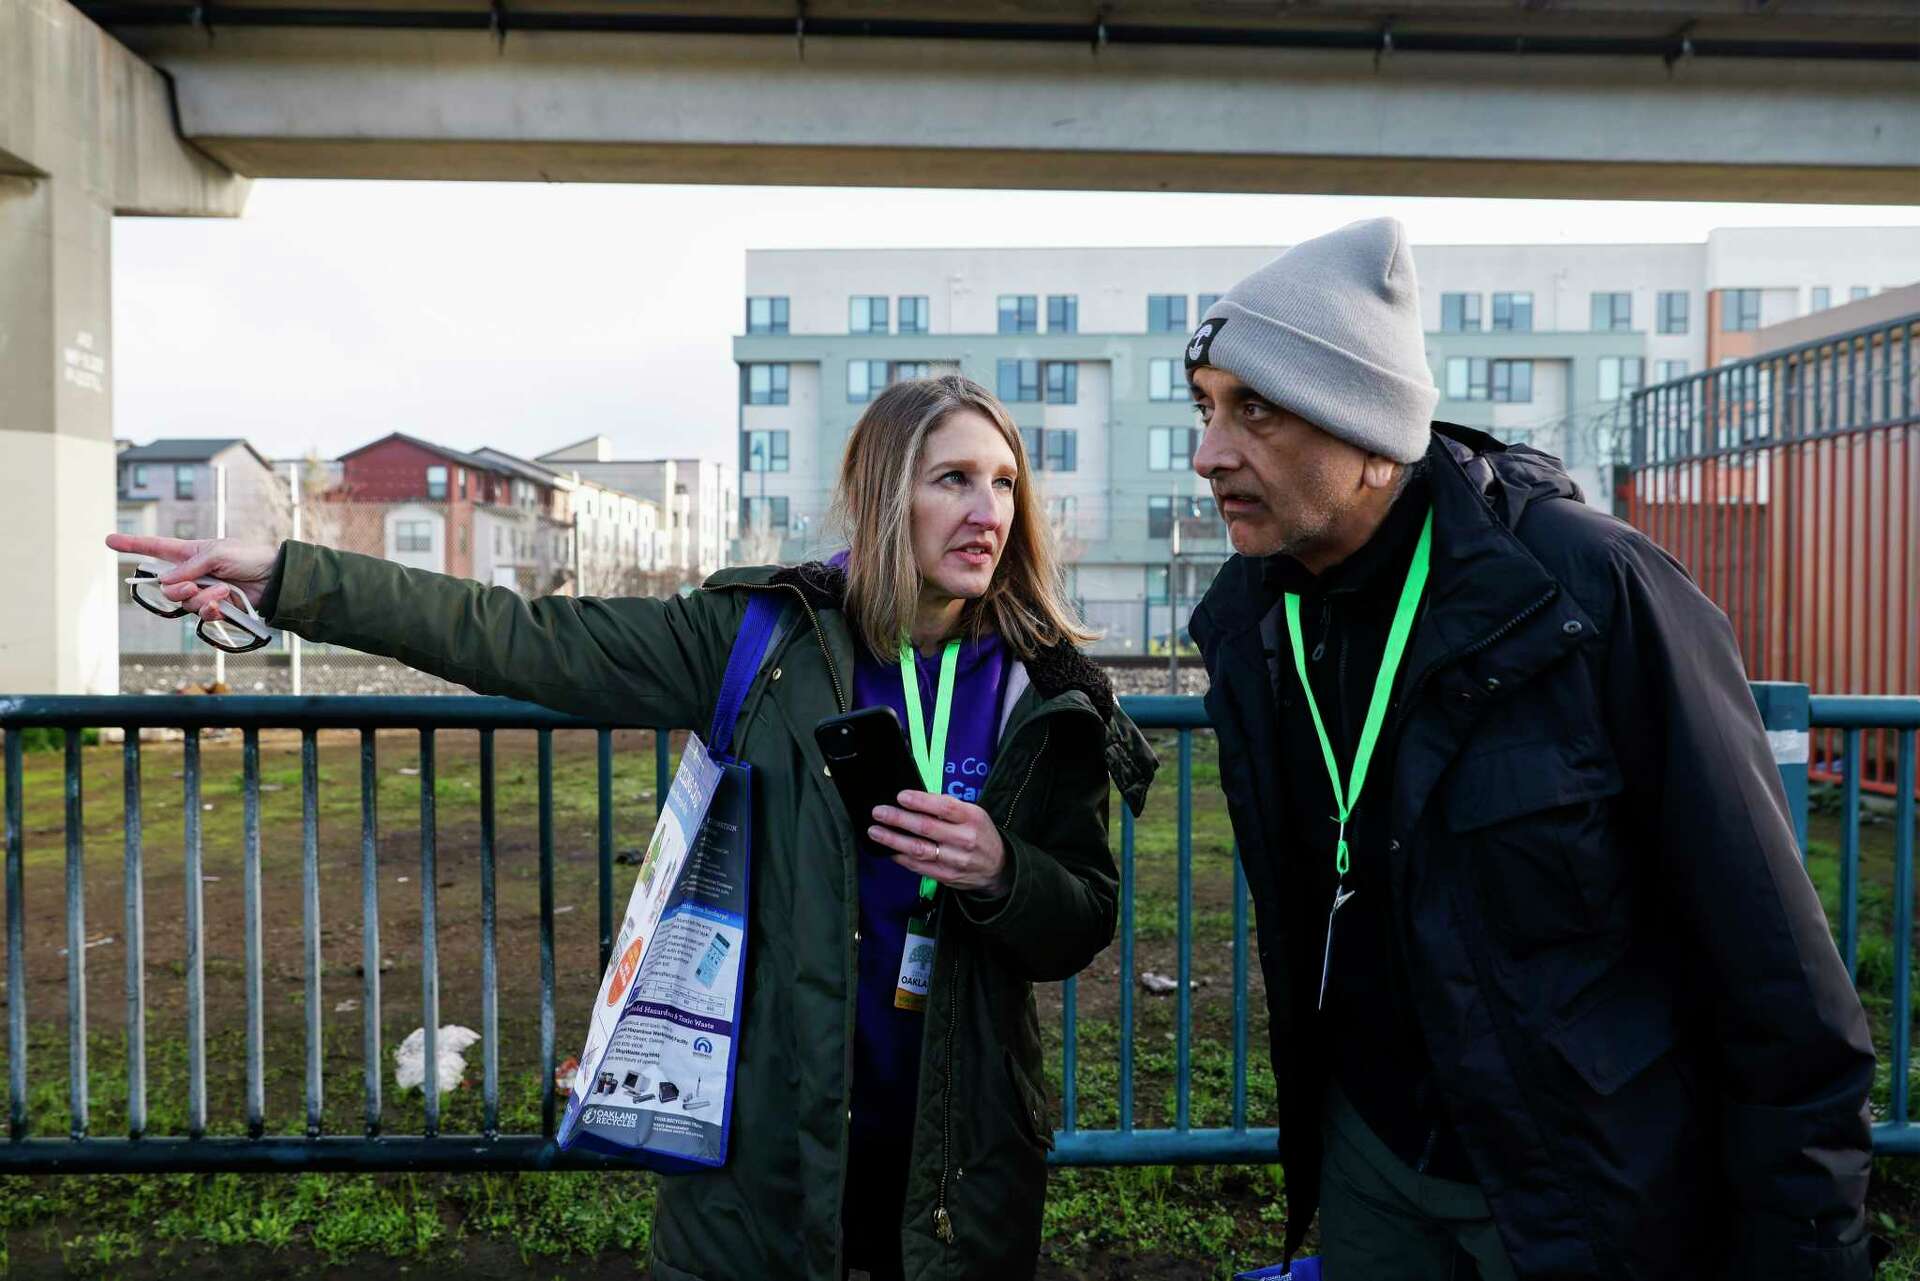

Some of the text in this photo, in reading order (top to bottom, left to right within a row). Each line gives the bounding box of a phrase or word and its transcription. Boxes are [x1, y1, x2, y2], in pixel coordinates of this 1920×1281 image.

[945, 757, 988, 776] a Co
[947, 781, 977, 801] Ca
[901, 975, 928, 988] OAKLA
[694, 1019, 715, 1030] Waste
[596, 1109, 638, 1121] OAKLAND
[596, 1117, 636, 1128] RECYCLES
